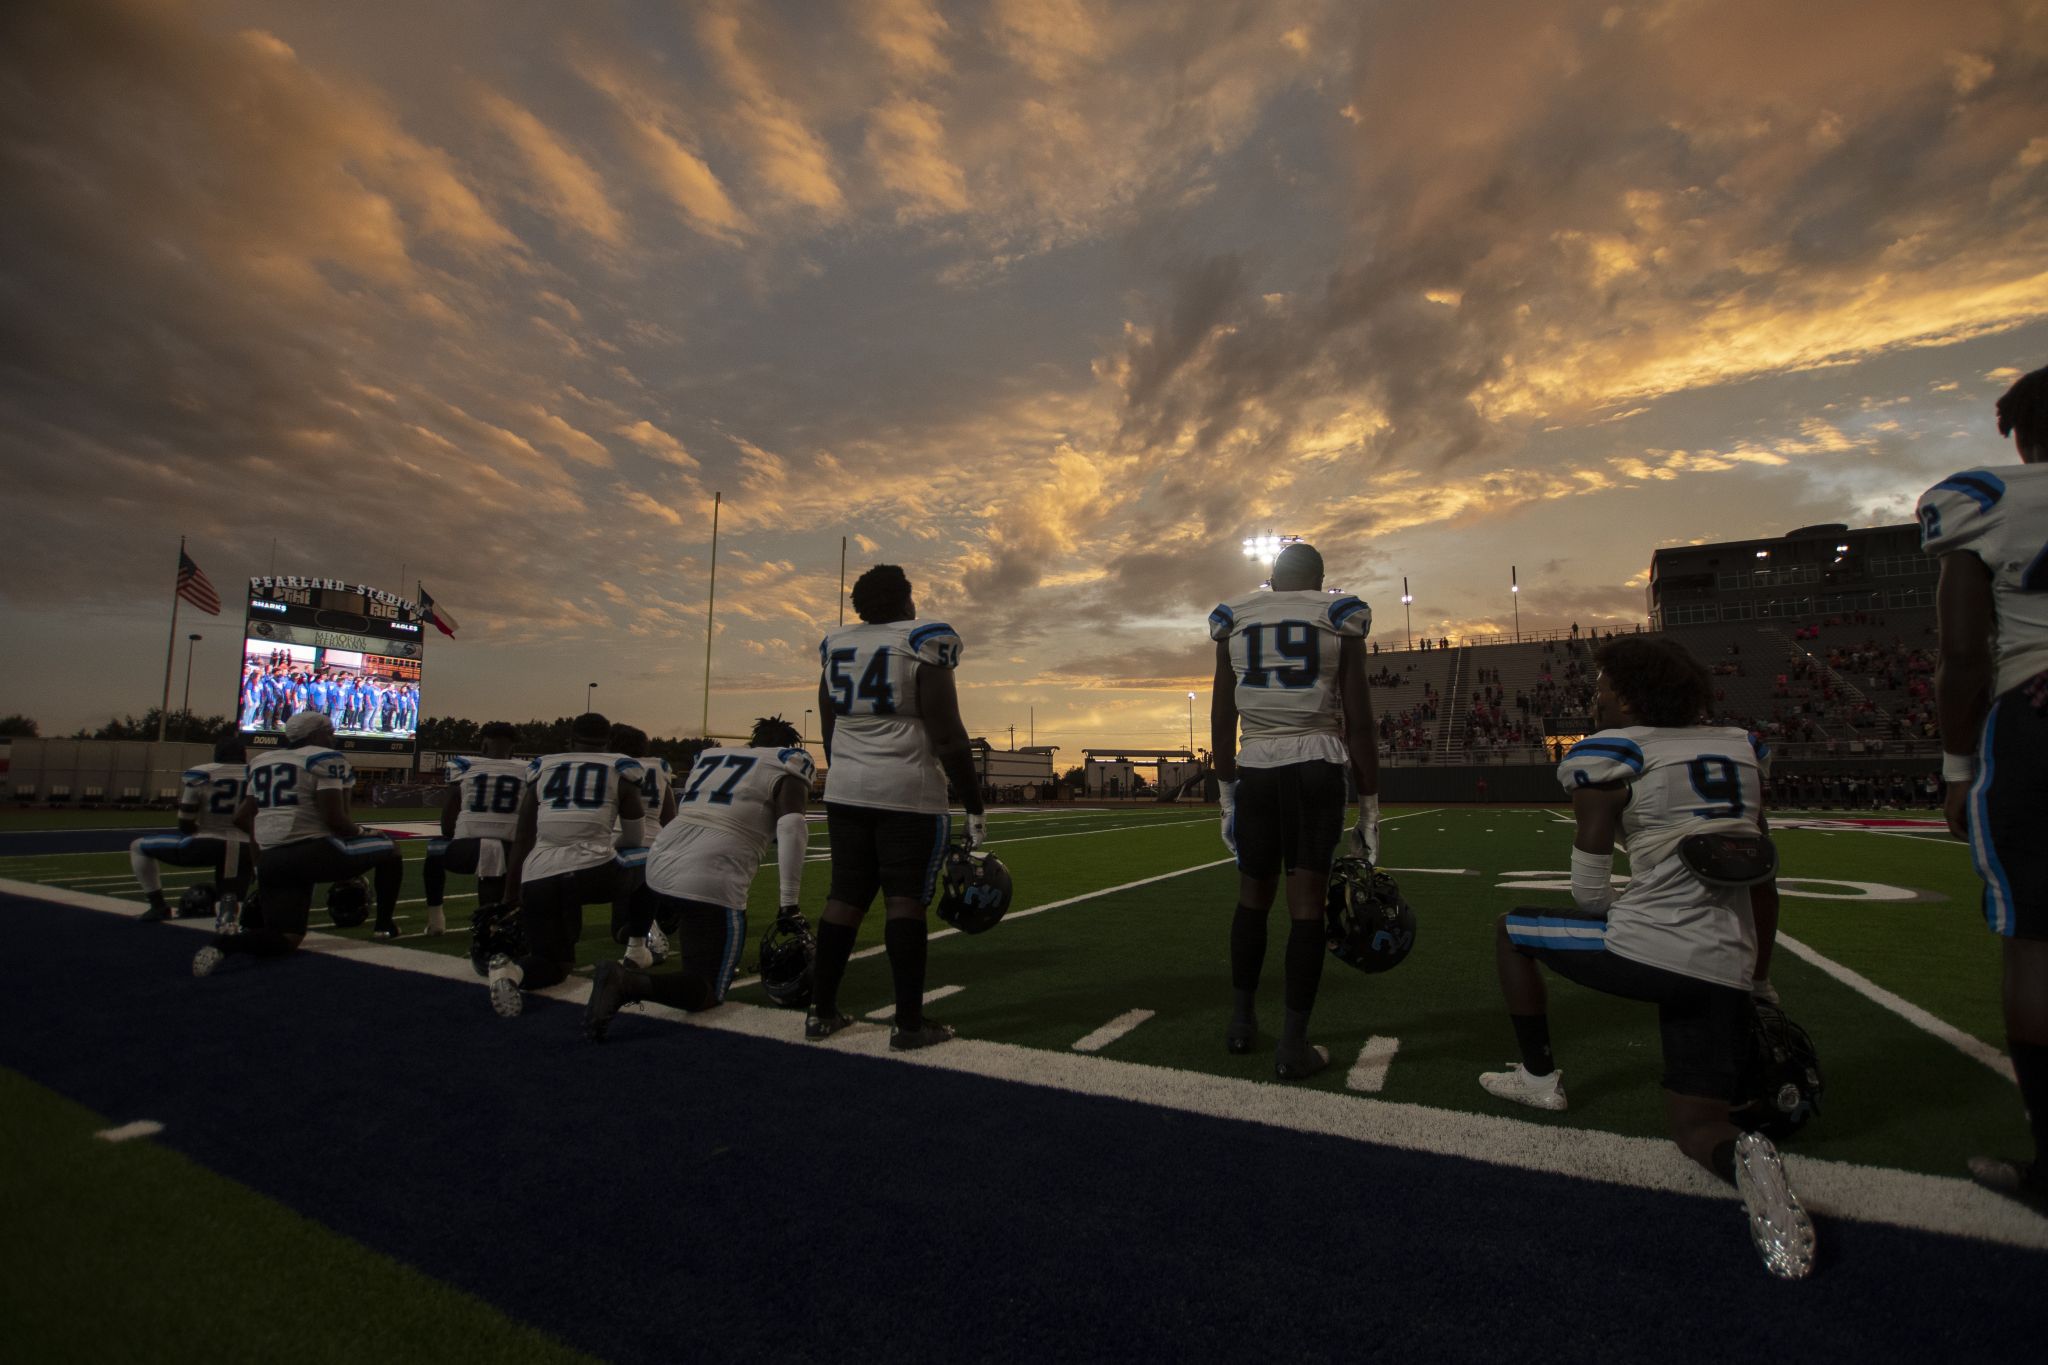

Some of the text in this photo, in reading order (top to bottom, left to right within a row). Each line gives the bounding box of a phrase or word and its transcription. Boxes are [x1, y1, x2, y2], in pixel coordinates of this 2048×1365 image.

[250, 576, 426, 618] PEARLAND STADIUM
[251, 599, 288, 613] SHARKS
[314, 631, 367, 645] MEMORIAL
[314, 637, 367, 651] HERMANN
[390, 622, 419, 632] EAGLES
[938, 643, 958, 668] 54
[1239, 619, 1321, 689] 19
[829, 646, 896, 715] 54
[252, 735, 279, 745] DOWN
[252, 763, 299, 807] 92
[328, 764, 347, 779] 92
[544, 761, 609, 809] 40
[682, 755, 755, 804] 77
[1688, 754, 1745, 820] 9
[469, 773, 521, 813] 18
